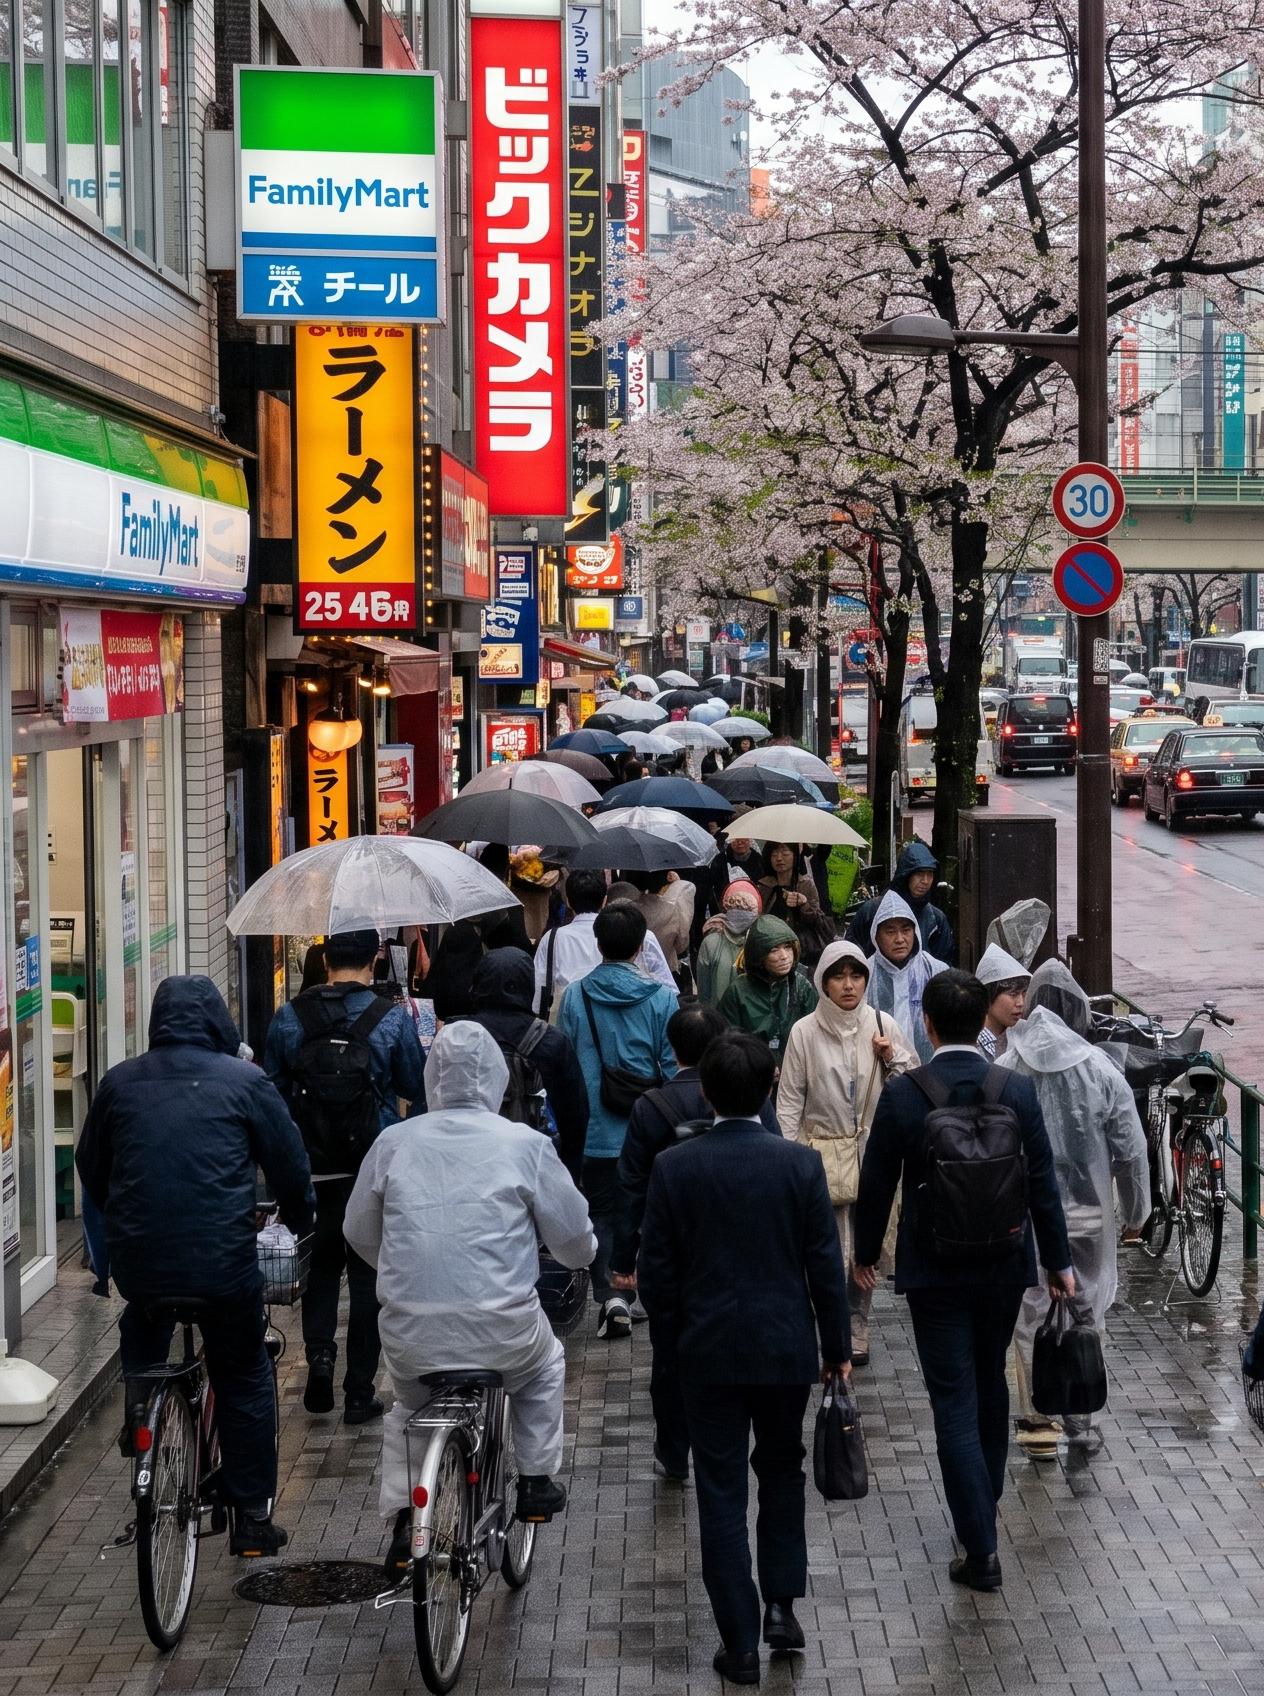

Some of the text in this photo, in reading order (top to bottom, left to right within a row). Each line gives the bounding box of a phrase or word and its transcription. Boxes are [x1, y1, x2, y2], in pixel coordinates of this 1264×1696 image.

[248, 175, 429, 212] FamilyMart
[485, 66, 553, 452] ビックカメラ
[323, 272, 420, 304] チール
[322, 344, 387, 574] ラーメン
[1068, 484, 1109, 518] 30
[120, 492, 199, 576] FamilyMart
[305, 591, 342, 621] 25
[313, 768, 339, 842] ラーメ
